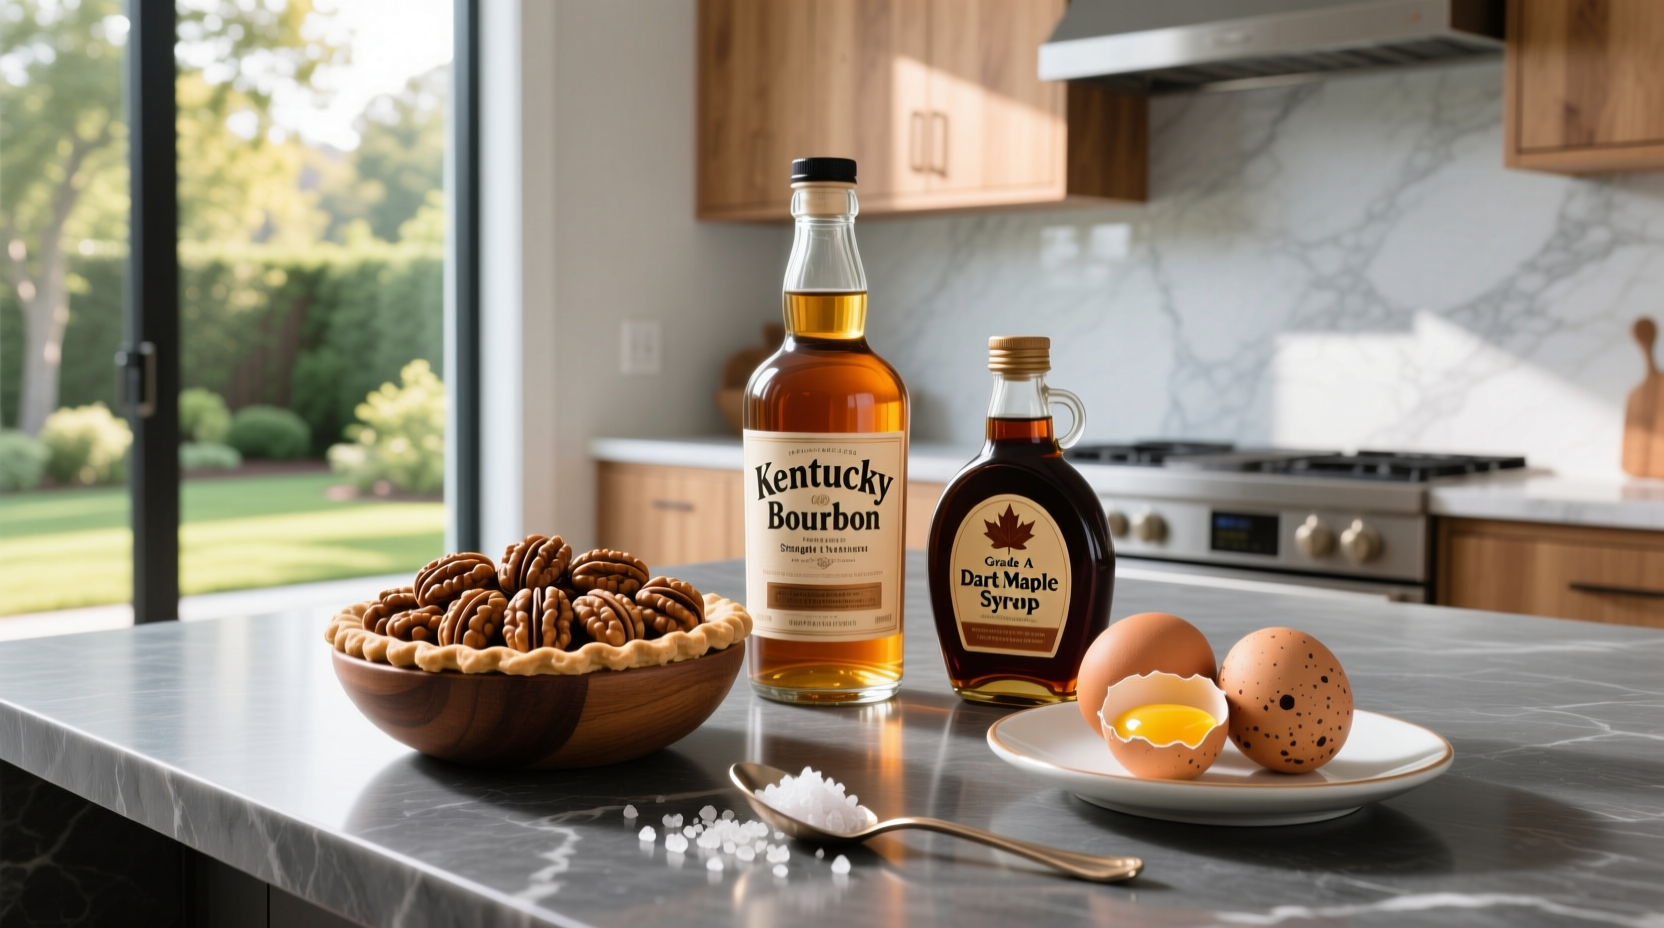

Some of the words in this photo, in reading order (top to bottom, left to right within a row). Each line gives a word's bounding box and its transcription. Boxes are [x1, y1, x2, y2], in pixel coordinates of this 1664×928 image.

[755, 459, 894, 505] Kentucky
[768, 501, 880, 531] Bourbon
[985, 556, 1019, 567] Grade
[1024, 557, 1034, 568] A
[961, 569, 999, 588] Dart
[1002, 571, 1058, 592] Maple
